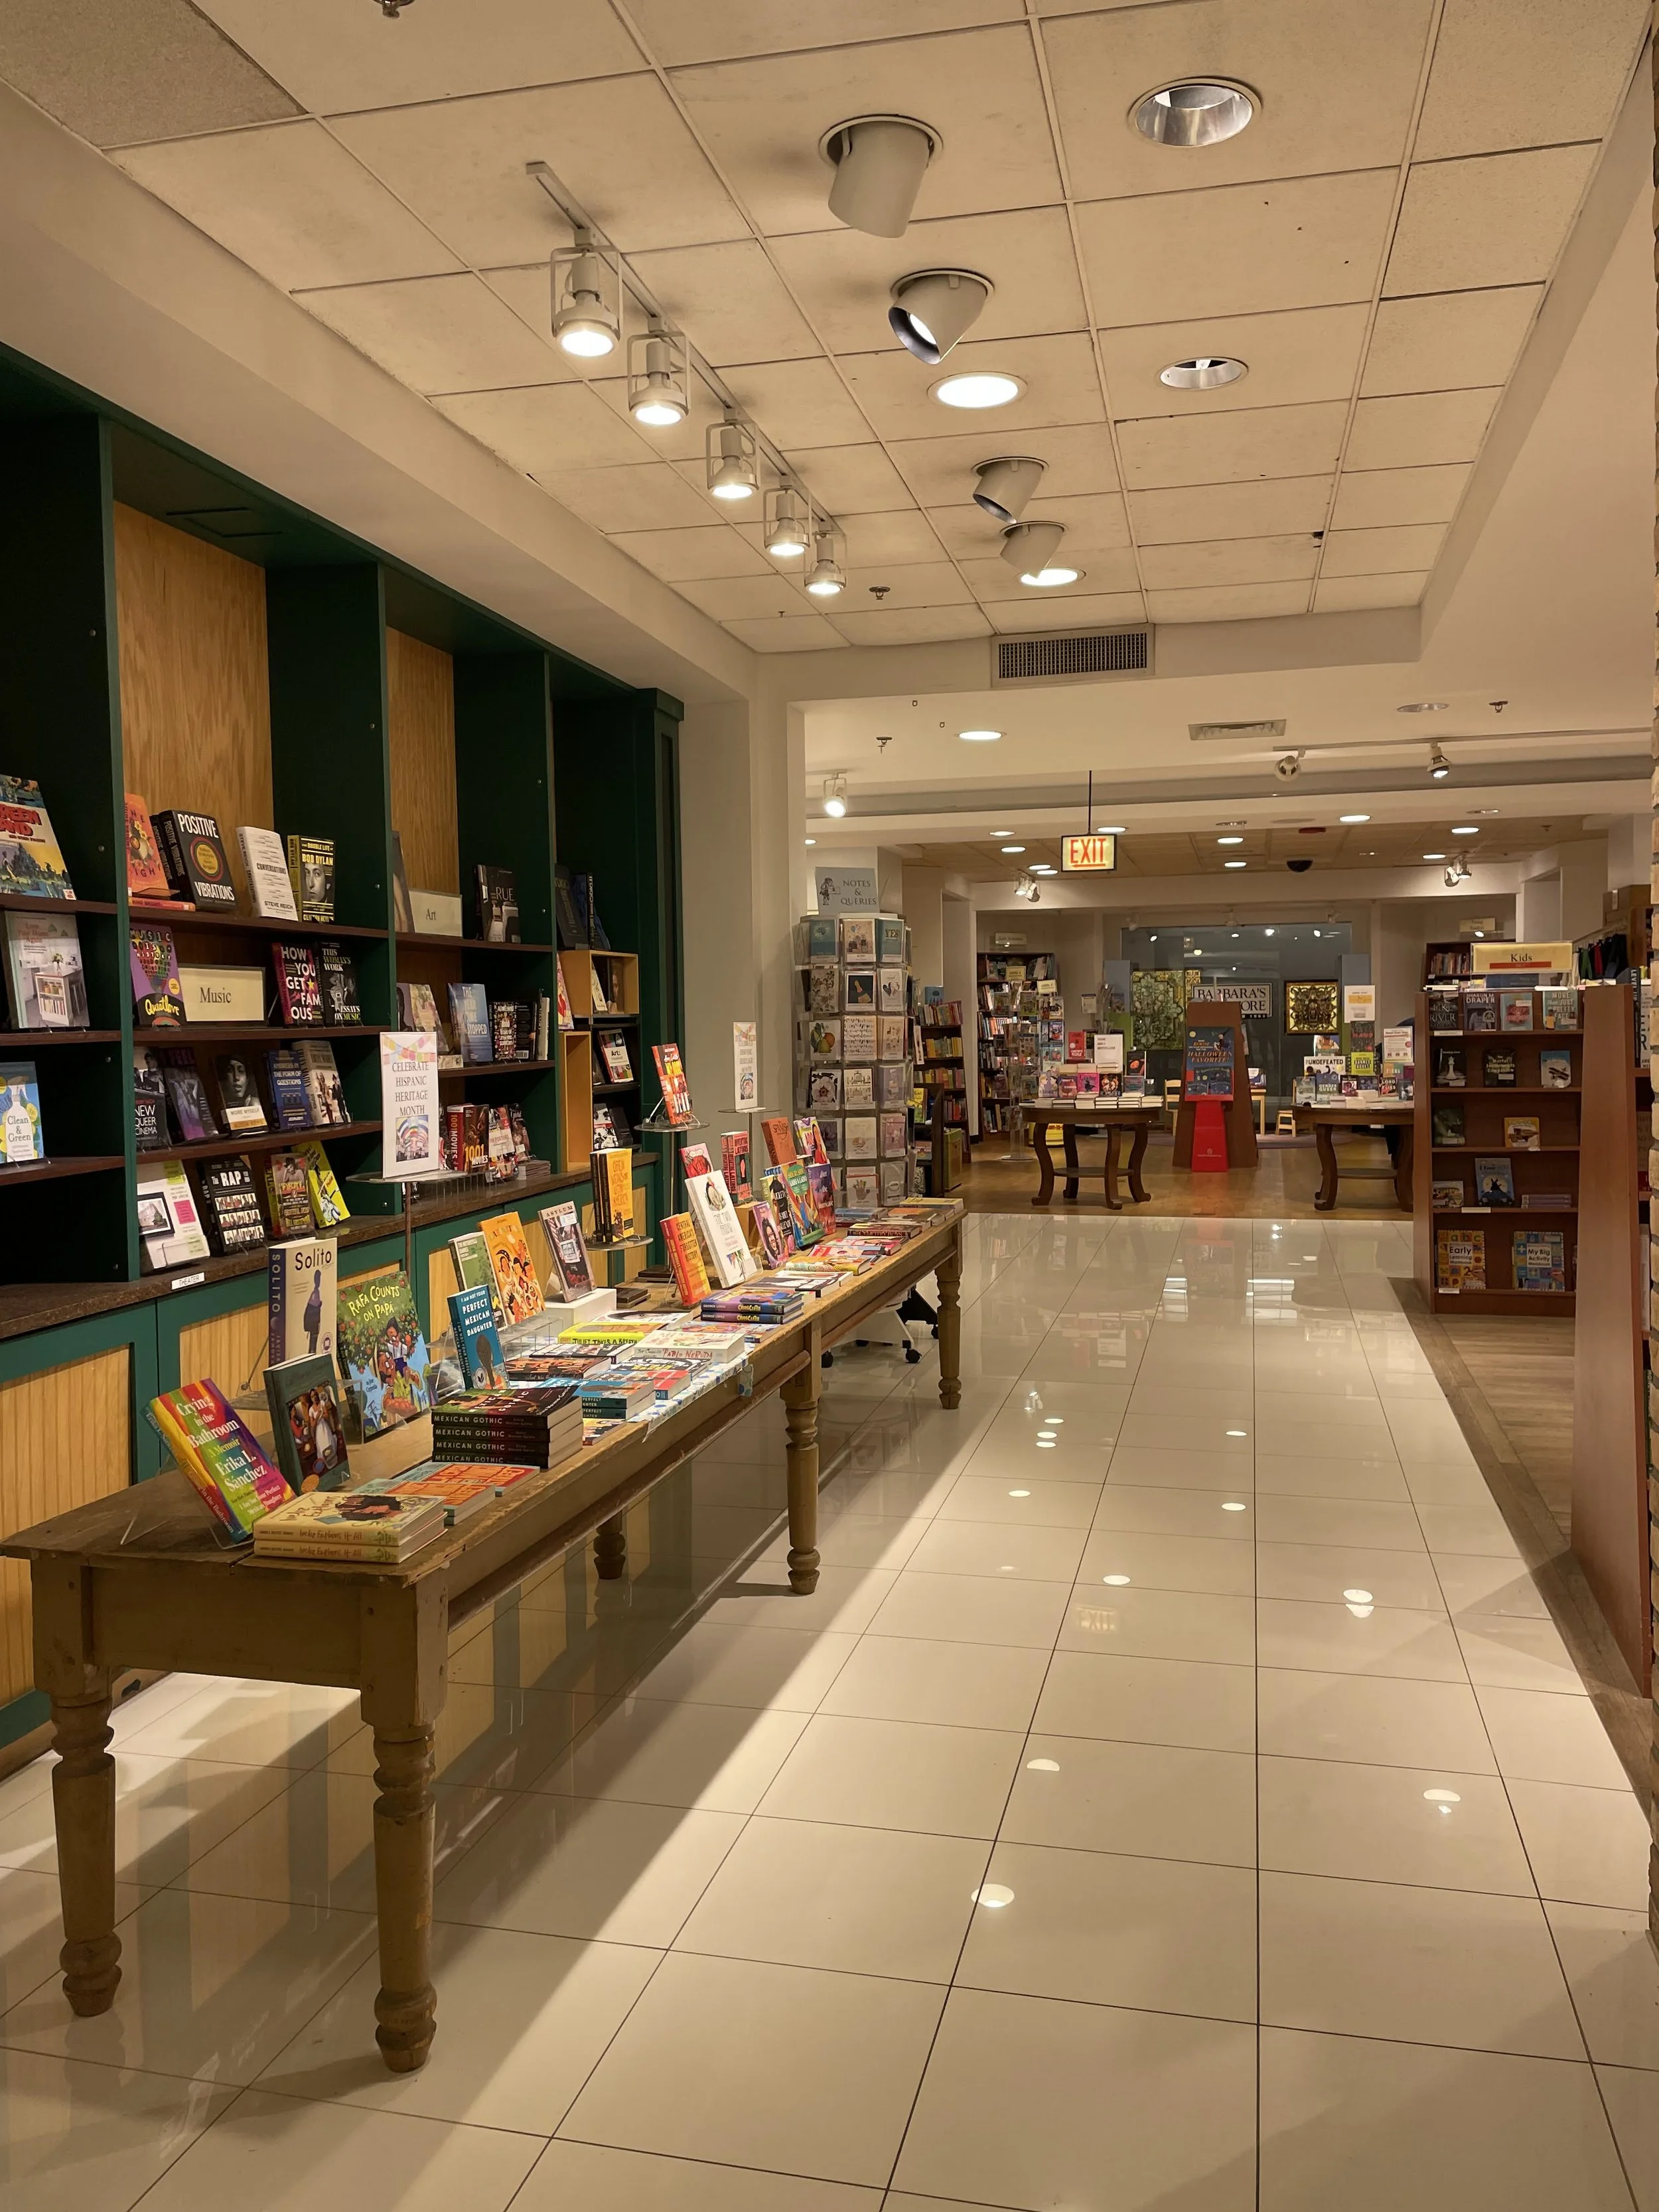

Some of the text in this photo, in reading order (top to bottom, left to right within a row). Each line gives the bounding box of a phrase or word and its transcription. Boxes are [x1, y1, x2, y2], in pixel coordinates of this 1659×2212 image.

[177, 814, 219, 838] POSITIVE
[1070, 838, 1106, 863] EXIT
[302, 853, 333, 865] BOB DYLAN
[257, 863, 287, 875] CONVERSATIONS
[194, 881, 235, 901] VIBRATIONS
[496, 887, 514, 901] RUE
[840, 897, 877, 906] QUERIES
[425, 909, 437, 921] Art
[130, 930, 171, 942] MUSIC
[280, 946, 307, 961] HOW
[1511, 954, 1532, 962] Kids
[323, 956, 351, 964] WOMAN'S
[295, 962, 316, 976] YOU
[286, 976, 305, 990] GET
[200, 987, 232, 1003] Music
[463, 986, 472, 997] THE
[301, 992, 321, 1005] FAM
[291, 1006, 313, 1020] OUS
[467, 1024, 487, 1035] STOPPED
[392, 1062, 429, 1072] CELEBRATE
[396, 1076, 427, 1087] HISPANIC
[395, 1090, 428, 1102] HERITAGE
[135, 1105, 155, 1116] NEW
[399, 1105, 425, 1116] MONTH
[7, 1116, 29, 1124] Clean
[135, 1116, 157, 1126] QUEER
[16, 1126, 22, 1134] &
[135, 1127, 157, 1136] CINEMA
[8, 1133, 31, 1142] Green
[465, 1144, 485, 1162] 1001
[472, 1155, 488, 1165] MOVIES
[220, 1171, 242, 1187] RAP
[546, 1205, 573, 1217] ASYLUM
[676, 1220, 691, 1231] CENTRAL
[678, 1228, 695, 1241] AMERICA'S
[680, 1239, 697, 1252] FORGOTTEN
[1449, 1246, 1471, 1255] Early
[295, 1248, 332, 1270] Solito
[685, 1250, 698, 1261] HISTORY
[178, 1275, 200, 1286] THEATER
[271, 1254, 281, 1313] SOLITO
[348, 1285, 400, 1316] RAFA COUNTS
[463, 1298, 488, 1315] PERFECT
[363, 1301, 395, 1321] ON PAPÁ
[465, 1309, 490, 1326] MEXICAN
[467, 1321, 493, 1337] DAUGHTER
[664, 1348, 713, 1359] PABLO NERUDA
[176, 1394, 215, 1417] Crying
[498, 1391, 529, 1412] GOTHIC
[195, 1413, 214, 1427] in the
[186, 1419, 240, 1449] Bathroom
[214, 1438, 241, 1455] Memoir
[216, 1454, 257, 1476] Erika L.
[213, 1504, 235, 1533] Bathroom
[353, 1531, 362, 1540] All
[353, 1548, 362, 1556] All
